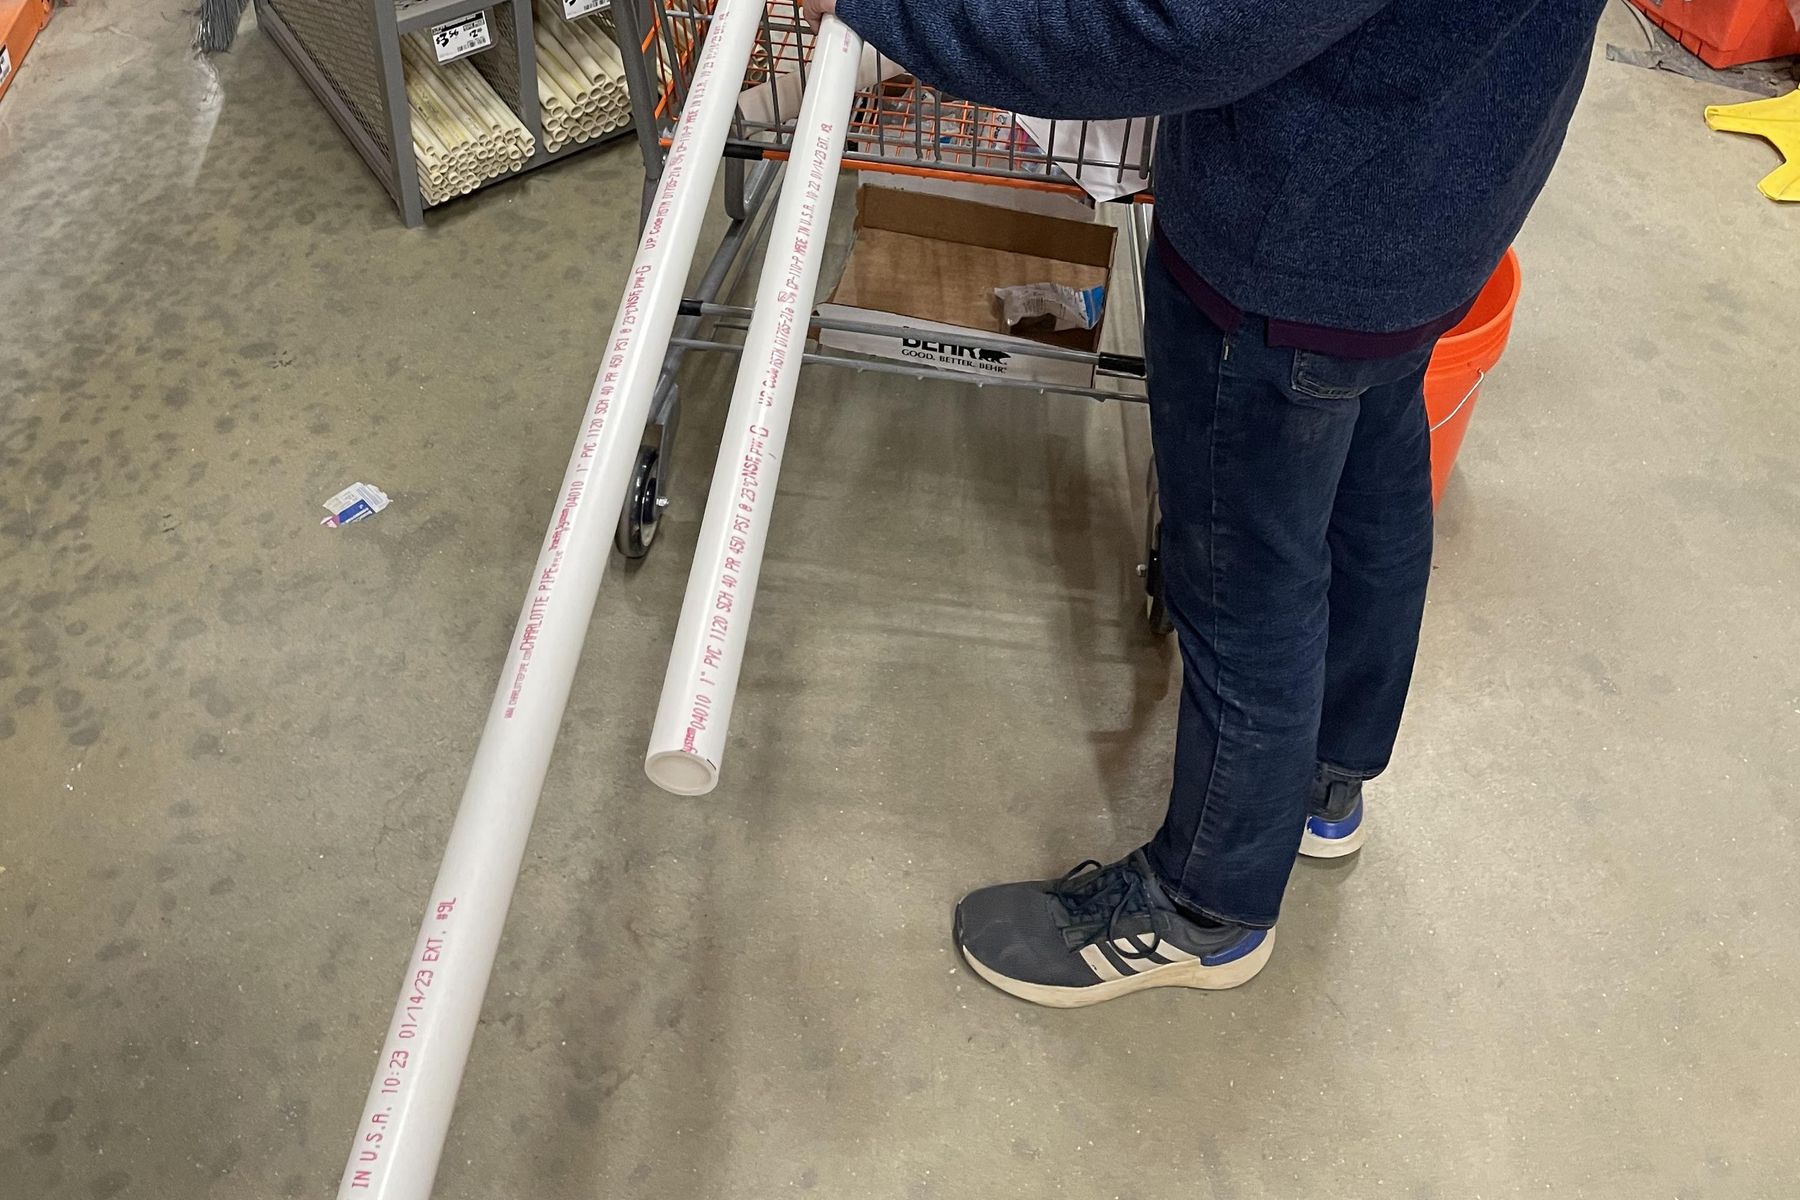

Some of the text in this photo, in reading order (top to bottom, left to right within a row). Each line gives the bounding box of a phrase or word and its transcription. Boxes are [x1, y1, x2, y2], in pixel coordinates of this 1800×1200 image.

[798, 226, 810, 236] IN
[794, 238, 808, 255] MADE
[614, 338, 629, 351] PSI
[609, 354, 623, 368] 450
[901, 348, 936, 361] GOOD.
[939, 355, 976, 367] BETTER.
[604, 372, 617, 382] PR
[600, 386, 614, 396] 40
[594, 400, 608, 414] SCH
[587, 418, 603, 438] 1120
[580, 442, 596, 458] PVC
[565, 480, 583, 508] 04010
[734, 514, 750, 534] PSI
[729, 536, 745, 554] 450
[724, 557, 740, 572] PR
[538, 568, 558, 592] PIPE
[722, 574, 737, 588] 40
[716, 591, 732, 612] SCH
[520, 598, 544, 652] CHARLOTTE
[710, 616, 728, 641] 1120
[704, 646, 722, 667] PVC
[691, 694, 710, 730] 04010
[422, 937, 443, 962] EXT.
[399, 970, 433, 1038] 01/14/23
[382, 1050, 408, 1092] 10:23
[360, 1108, 390, 1162] U.S.A.
[352, 1170, 370, 1188] IN
